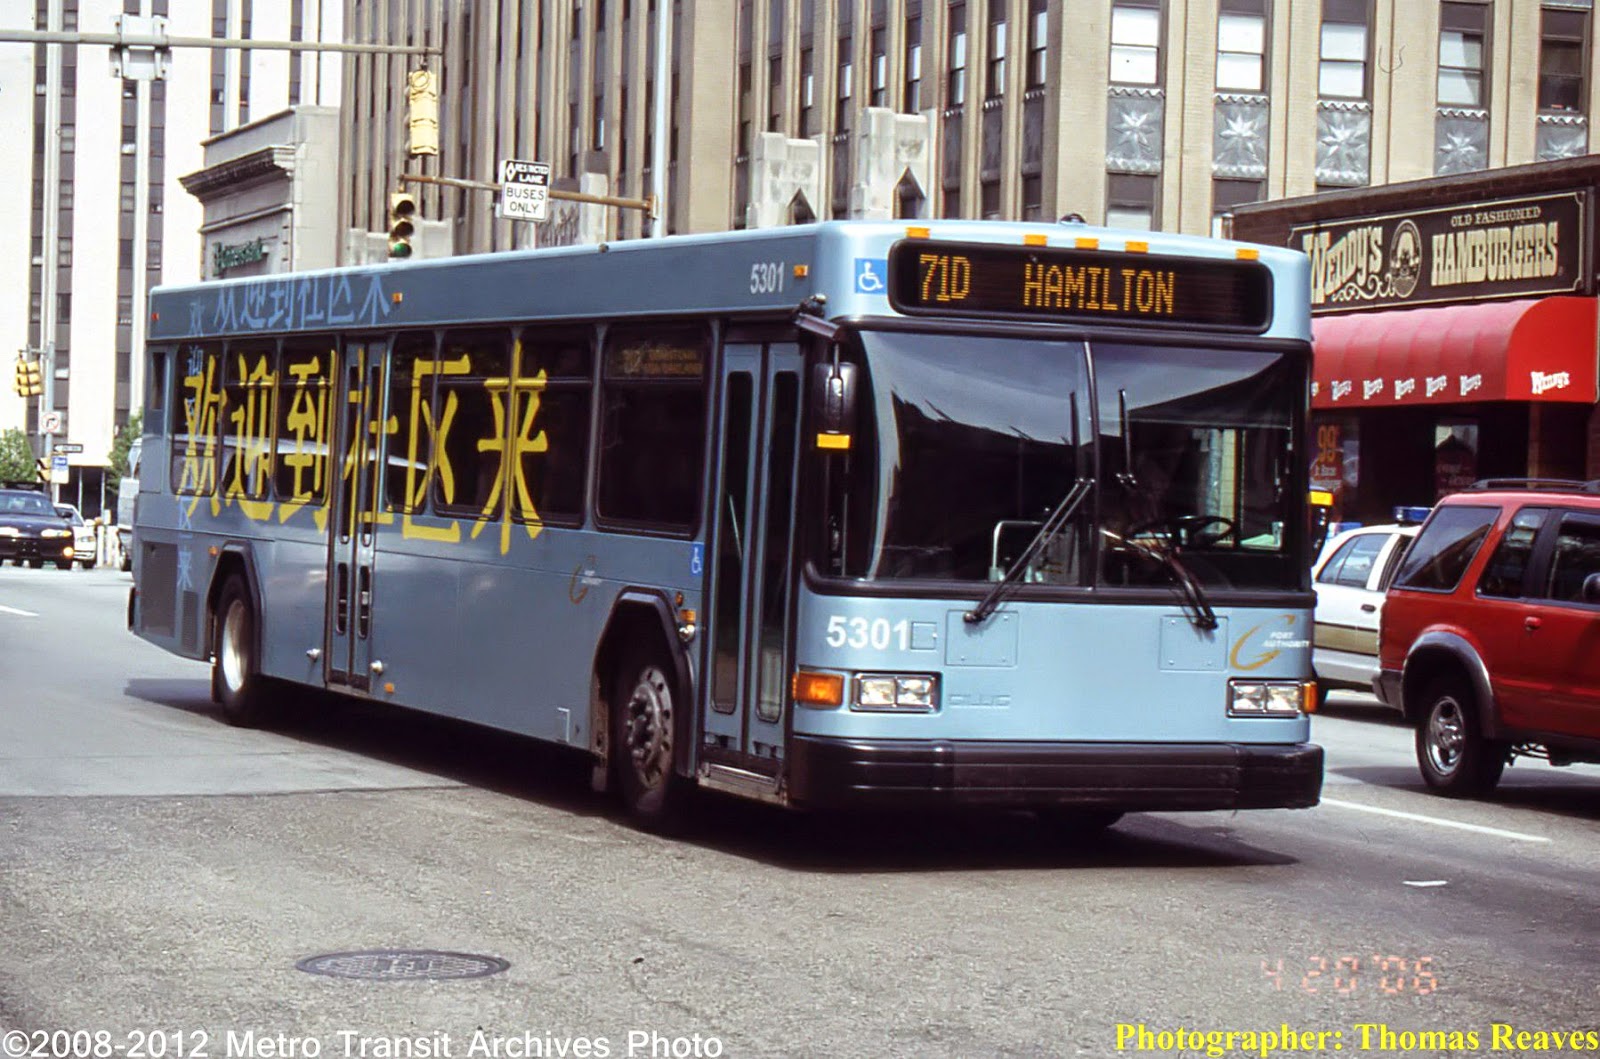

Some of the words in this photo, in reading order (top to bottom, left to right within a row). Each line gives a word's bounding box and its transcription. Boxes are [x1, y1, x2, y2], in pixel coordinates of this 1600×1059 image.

[519, 174, 544, 184] LANE
[506, 187, 545, 200] BUSES
[509, 201, 539, 214] ONLY
[1451, 214, 1473, 228] OLD
[1475, 206, 1542, 225] FASHIONED
[1431, 222, 1558, 286] HAMBURGERS
[750, 261, 785, 295] 5301
[919, 253, 971, 301] 71D
[1024, 263, 1174, 314] HAMILTON
[826, 614, 908, 651] 5301
